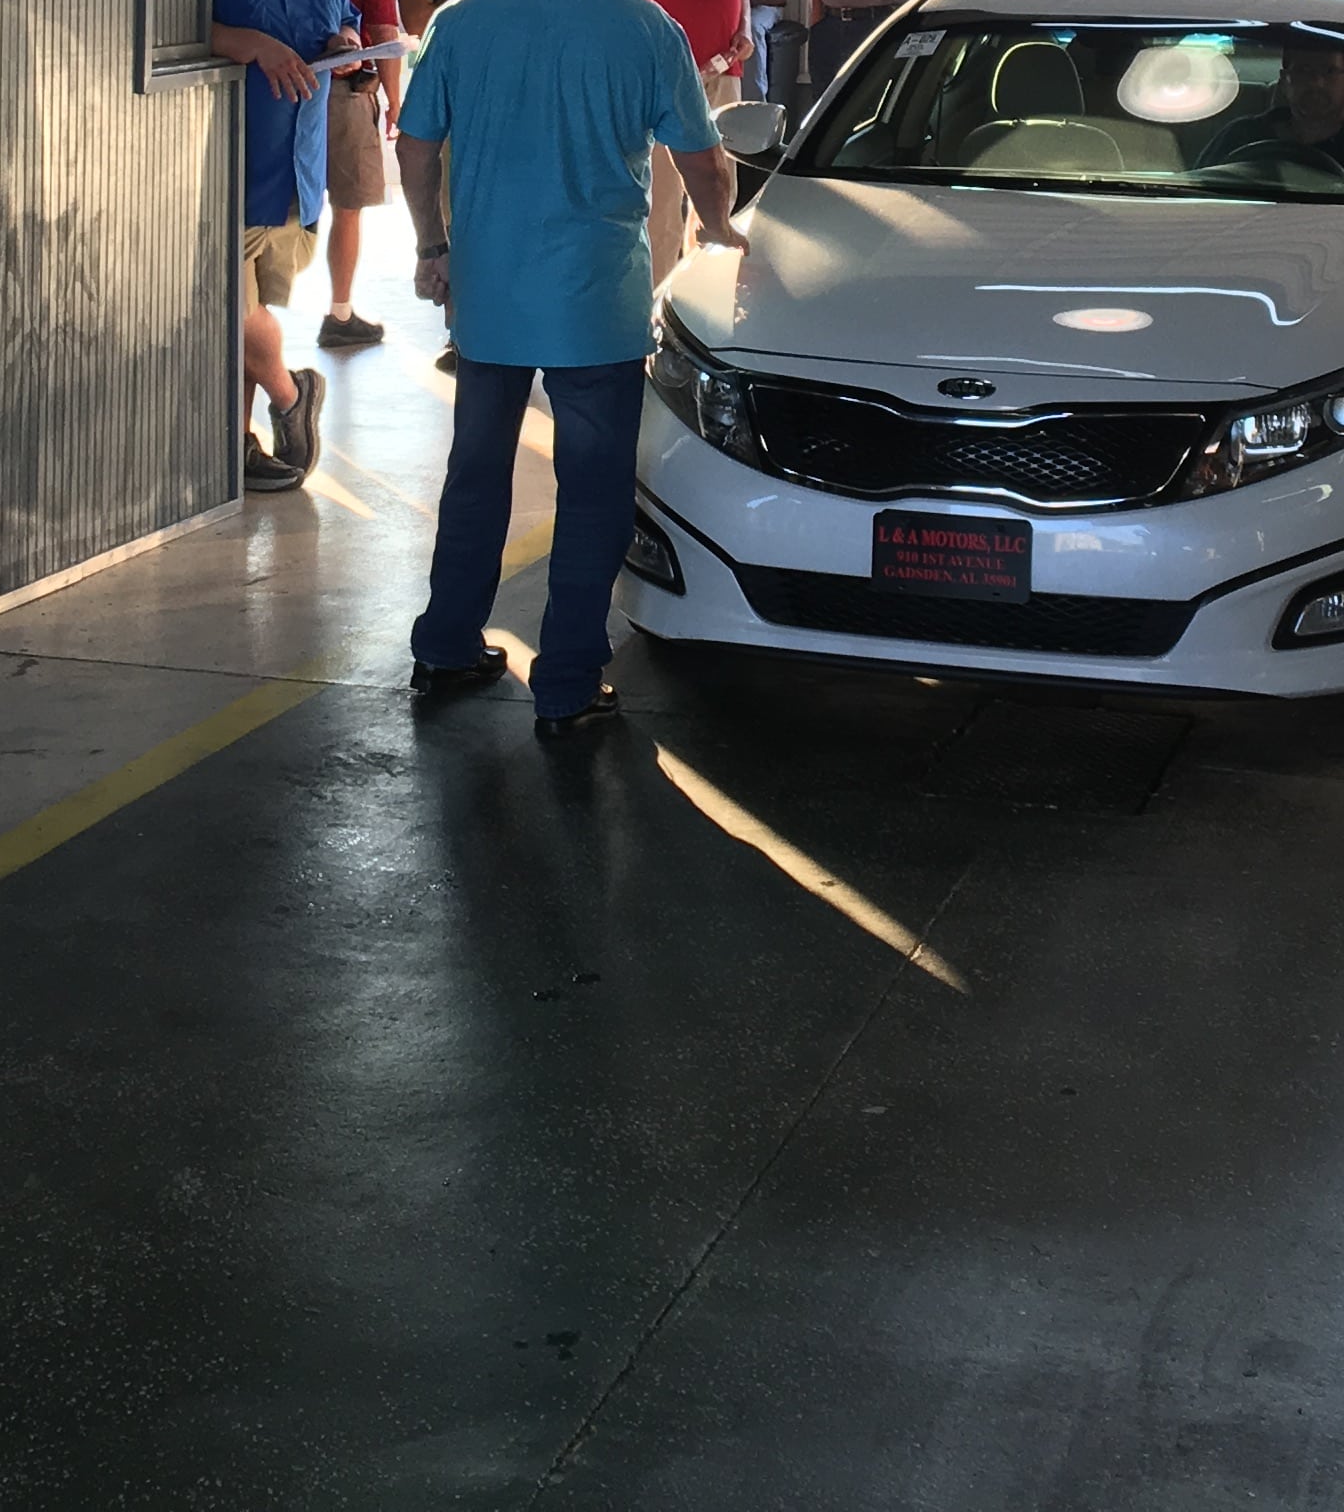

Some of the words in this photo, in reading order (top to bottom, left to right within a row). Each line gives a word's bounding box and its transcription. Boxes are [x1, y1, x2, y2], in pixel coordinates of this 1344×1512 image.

[878, 525, 890, 543] L
[892, 526, 905, 544] &
[907, 527, 919, 545] A
[921, 529, 991, 553] MOTORS,
[993, 534, 1026, 554] LLC
[949, 554, 1006, 570] AVENUE
[959, 571, 978, 585] AL
